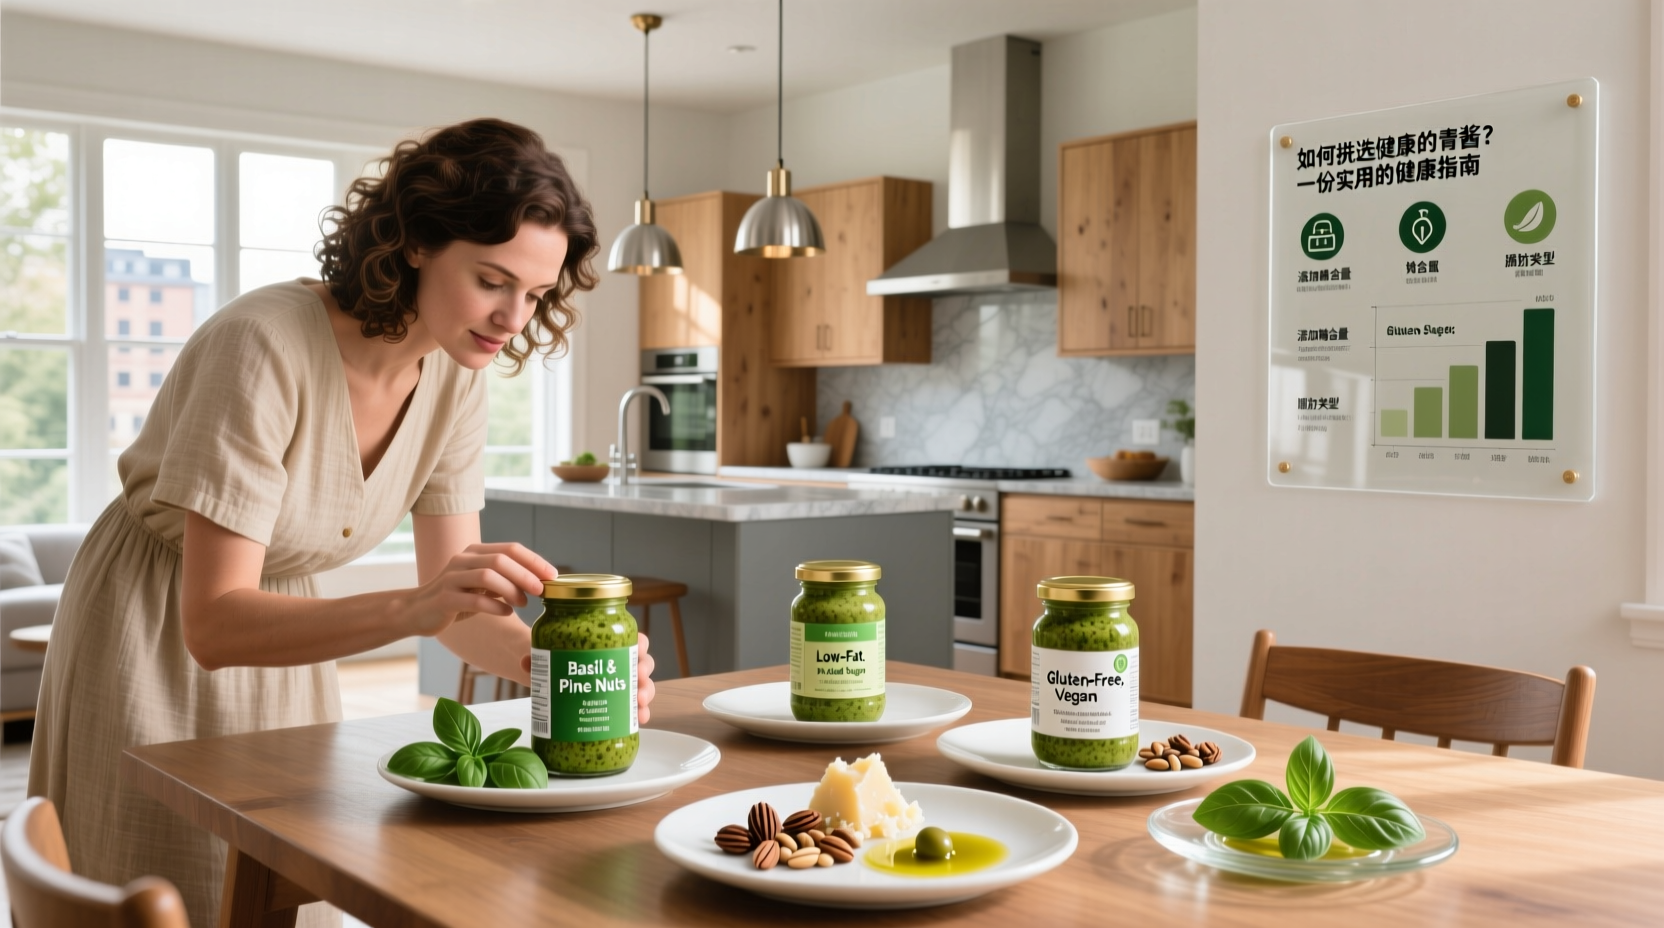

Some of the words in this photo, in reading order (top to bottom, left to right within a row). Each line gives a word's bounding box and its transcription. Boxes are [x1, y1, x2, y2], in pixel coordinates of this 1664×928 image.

[1297, 153, 1481, 193] 一份实用的健康指南
[568, 659, 603, 675] Basil
[606, 659, 617, 675] &
[595, 677, 627, 692] Nuts
[1047, 670, 1124, 688] Gluten-Free,
[1055, 688, 1098, 705] Vegan
